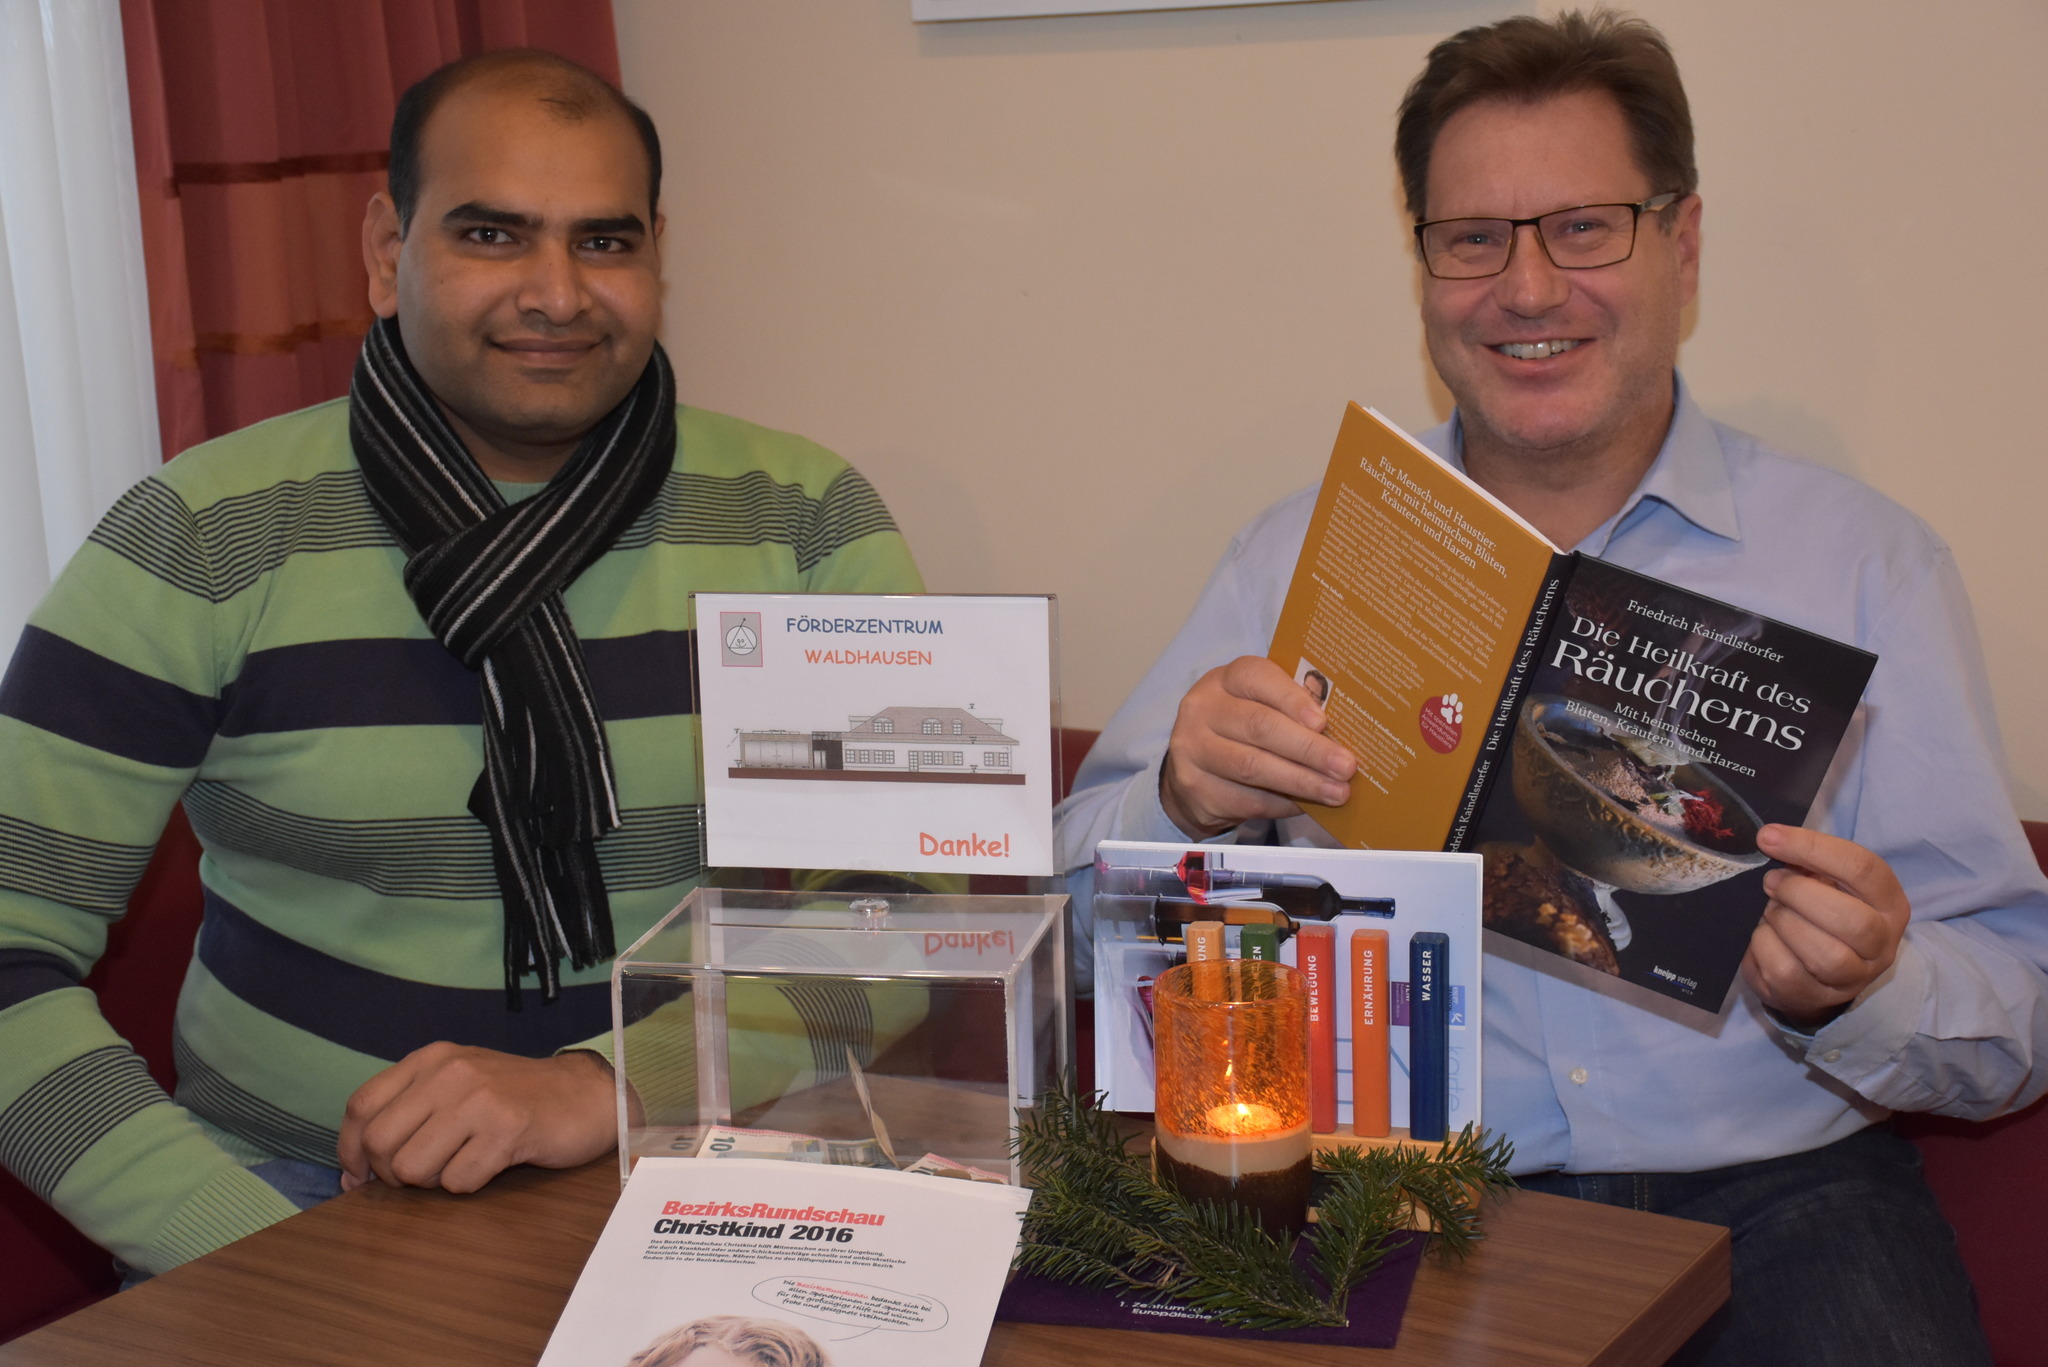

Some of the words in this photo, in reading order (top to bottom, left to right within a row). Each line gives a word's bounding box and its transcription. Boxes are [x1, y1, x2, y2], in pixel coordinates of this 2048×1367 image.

[1360, 457, 1402, 496] Räuchern
[1403, 493, 1419, 509] mit
[1421, 503, 1472, 550] heimischen
[1474, 544, 1507, 578] Blüten,
[1379, 456, 1396, 474] Für
[1397, 469, 1432, 503] Mensch
[1433, 499, 1453, 518] und
[1454, 512, 1496, 551] Haustier:
[1381, 489, 1421, 527] Kräutern
[1423, 524, 1442, 542] und
[1442, 536, 1476, 569] Harzen
[786, 615, 944, 635] FÖRDERZENTRUM
[1627, 600, 1688, 630] Friedrich
[1691, 621, 1785, 664] Kaindlstorfer
[804, 649, 932, 666] WALDHAUSEN
[1572, 616, 1620, 646] Die
[1628, 635, 1751, 693] Heilkraft
[1757, 684, 1810, 713] des
[1459, 760, 1490, 823] Kaindlstorfer
[1486, 730, 1501, 750] Die
[1495, 677, 1522, 727] Heilkraft
[1516, 650, 1532, 673] des
[1525, 580, 1559, 646] Räucherns
[1551, 639, 1806, 750] Räucherns
[1421, 713, 1457, 745] Anwendungen
[1421, 720, 1429, 729] für
[1429, 727, 1452, 749] Haustiere
[1424, 707, 1433, 717] Mit
[1433, 715, 1458, 737] speziellen
[1612, 702, 1642, 721] Mit
[1640, 711, 1718, 749] heimischen
[1564, 700, 1612, 727] Blüten,
[1615, 719, 1677, 748] Kräutern
[1678, 739, 1706, 759] und
[1707, 751, 1756, 778] Harzen
[919, 831, 1011, 858] Danke!
[1308, 955, 1319, 1022] BEWEGUNG
[1363, 950, 1374, 1025] ERNÄHRUNG
[1421, 949, 1432, 1001] WASSER
[1653, 965, 1677, 981] kneipp
[1677, 975, 1698, 990] verlag
[709, 1136, 736, 1151] 10
[661, 1200, 885, 1227] BezirksRundschau
[652, 1218, 782, 1240] Christkind
[791, 1225, 854, 1244] 2016
[696, 1257, 757, 1265] BezirksRundschau.
[751, 1249, 809, 1257] Schicksalsschläge
[853, 1255, 906, 1265] unbürokratische
[797, 1257, 842, 1265] Hilfsprojekten
[848, 1249, 884, 1257] Umgebung,
[783, 1279, 795, 1287] Die
[871, 1295, 902, 1306] bedankt
[903, 1302, 919, 1310] sich
[921, 1304, 932, 1312] bei
[788, 1287, 808, 1295] allen
[809, 1290, 862, 1304] Spenderinnen
[864, 1300, 882, 1308] und
[882, 1304, 919, 1315] Spendern
[806, 1296, 851, 1309] großzügige
[852, 1304, 872, 1313] Hilfe
[873, 1308, 889, 1316] und
[891, 1312, 924, 1323] wünscht
[1132, 1302, 1185, 1311] Zentrum
[782, 1298, 802, 1307] frohe
[803, 1301, 820, 1309] und
[820, 1306, 858, 1317] gesegnete
[859, 1312, 910, 1327] Weihnachten.
[1132, 1308, 1212, 1320] Europäische
